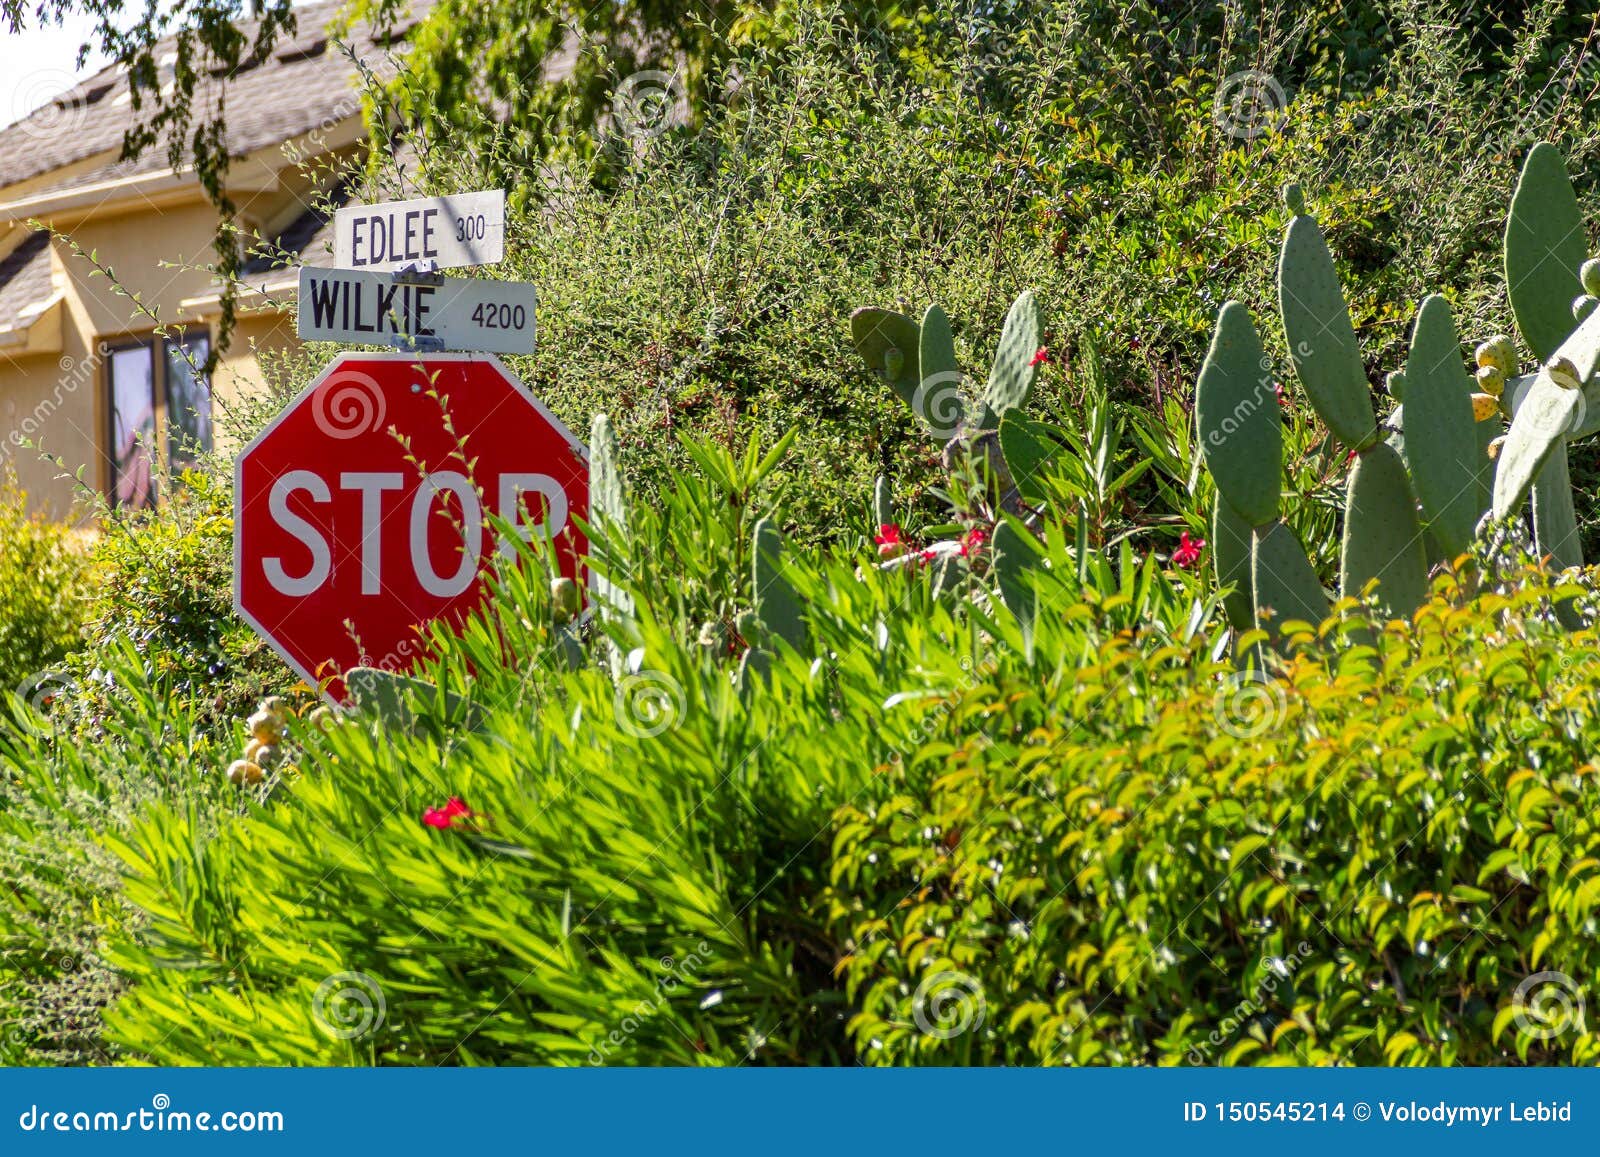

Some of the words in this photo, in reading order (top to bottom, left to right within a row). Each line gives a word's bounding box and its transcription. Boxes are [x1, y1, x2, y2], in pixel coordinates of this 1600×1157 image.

[352, 208, 438, 267] EDLEE
[456, 214, 485, 243] 300
[310, 278, 436, 336] WILKIE
[471, 302, 526, 331] 4200
[261, 469, 568, 598] STOP
